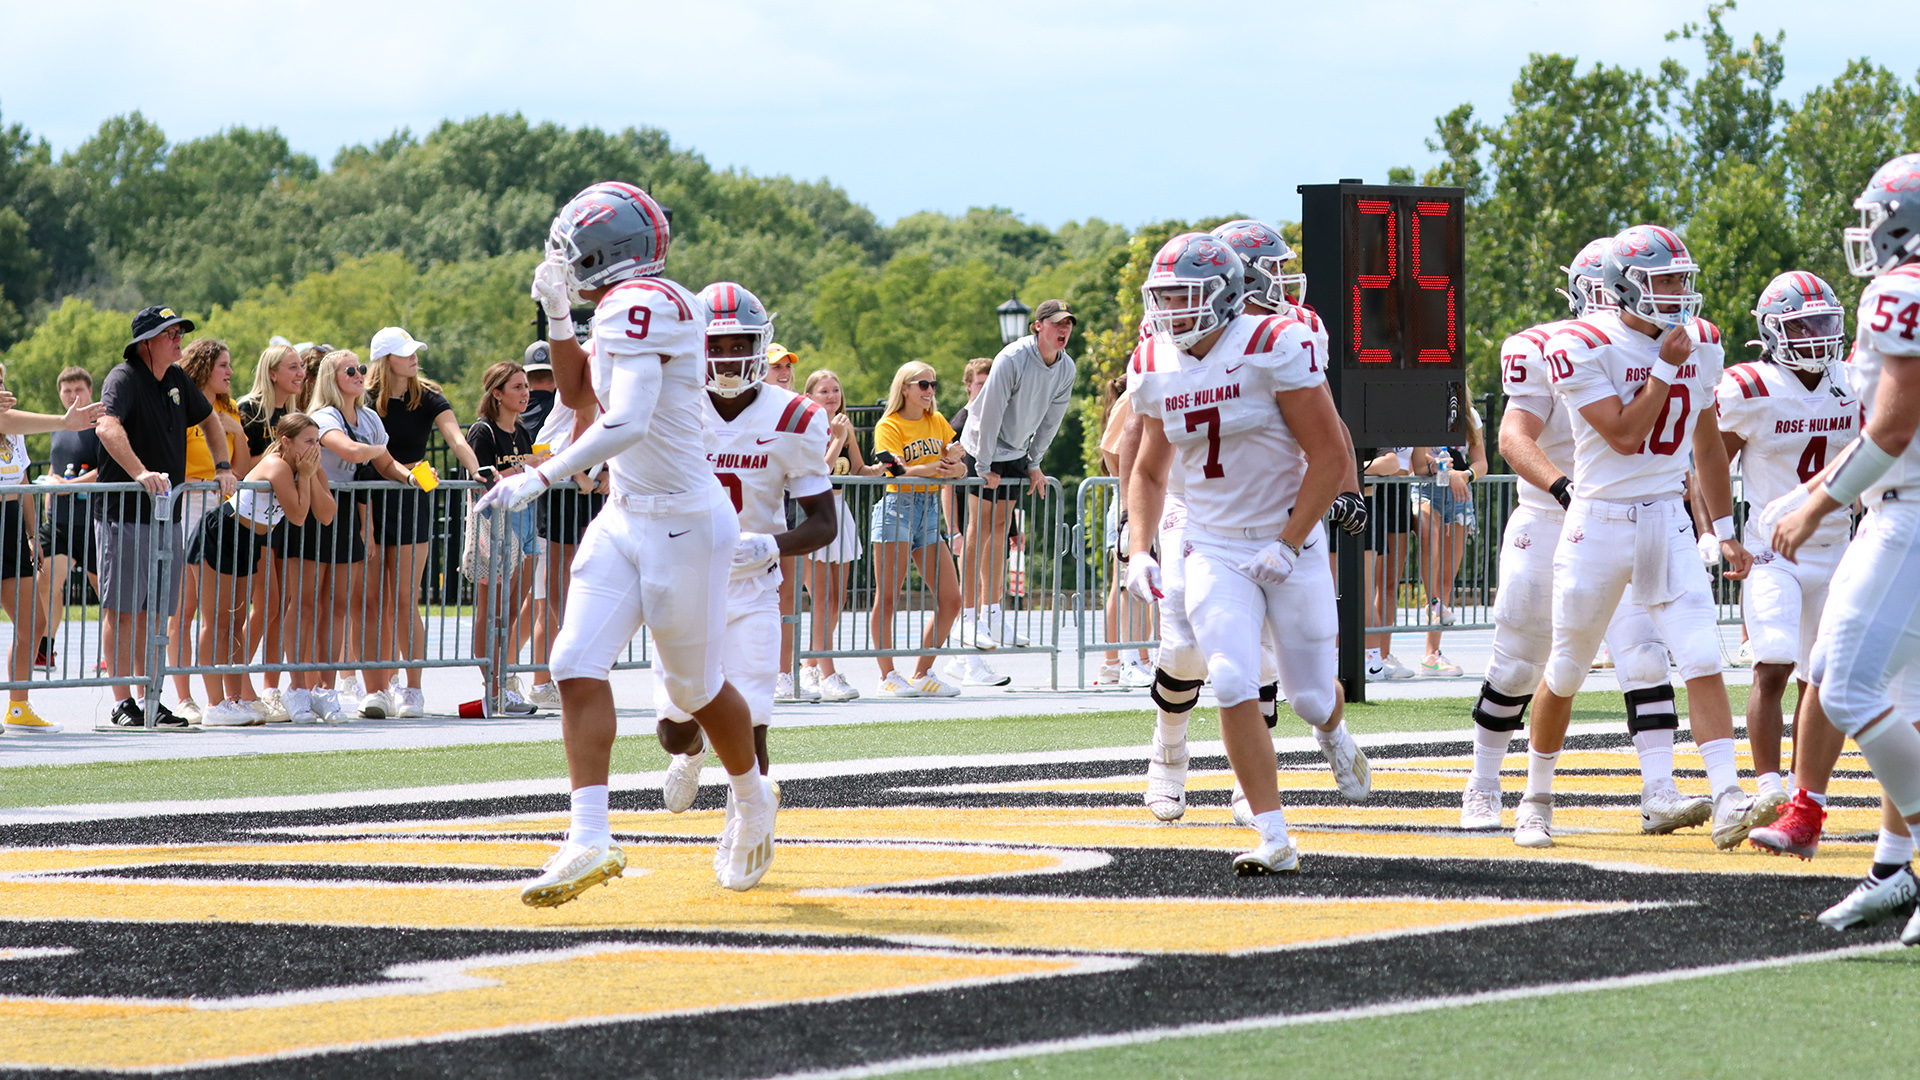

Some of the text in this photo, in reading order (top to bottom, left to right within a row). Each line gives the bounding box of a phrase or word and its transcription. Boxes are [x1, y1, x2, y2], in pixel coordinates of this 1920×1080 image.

[1353, 200, 1456, 364] 25
[625, 304, 652, 340] 9
[1870, 294, 1920, 341] 54
[1300, 340, 1318, 373] 7
[1503, 354, 1527, 383] 75
[1546, 349, 1574, 384] 10
[1165, 383, 1240, 412] ROSE-HULMAN
[1775, 415, 1852, 433] ROSE-HULMAN
[1184, 406, 1225, 479] 7
[1796, 436, 1827, 484] 4
